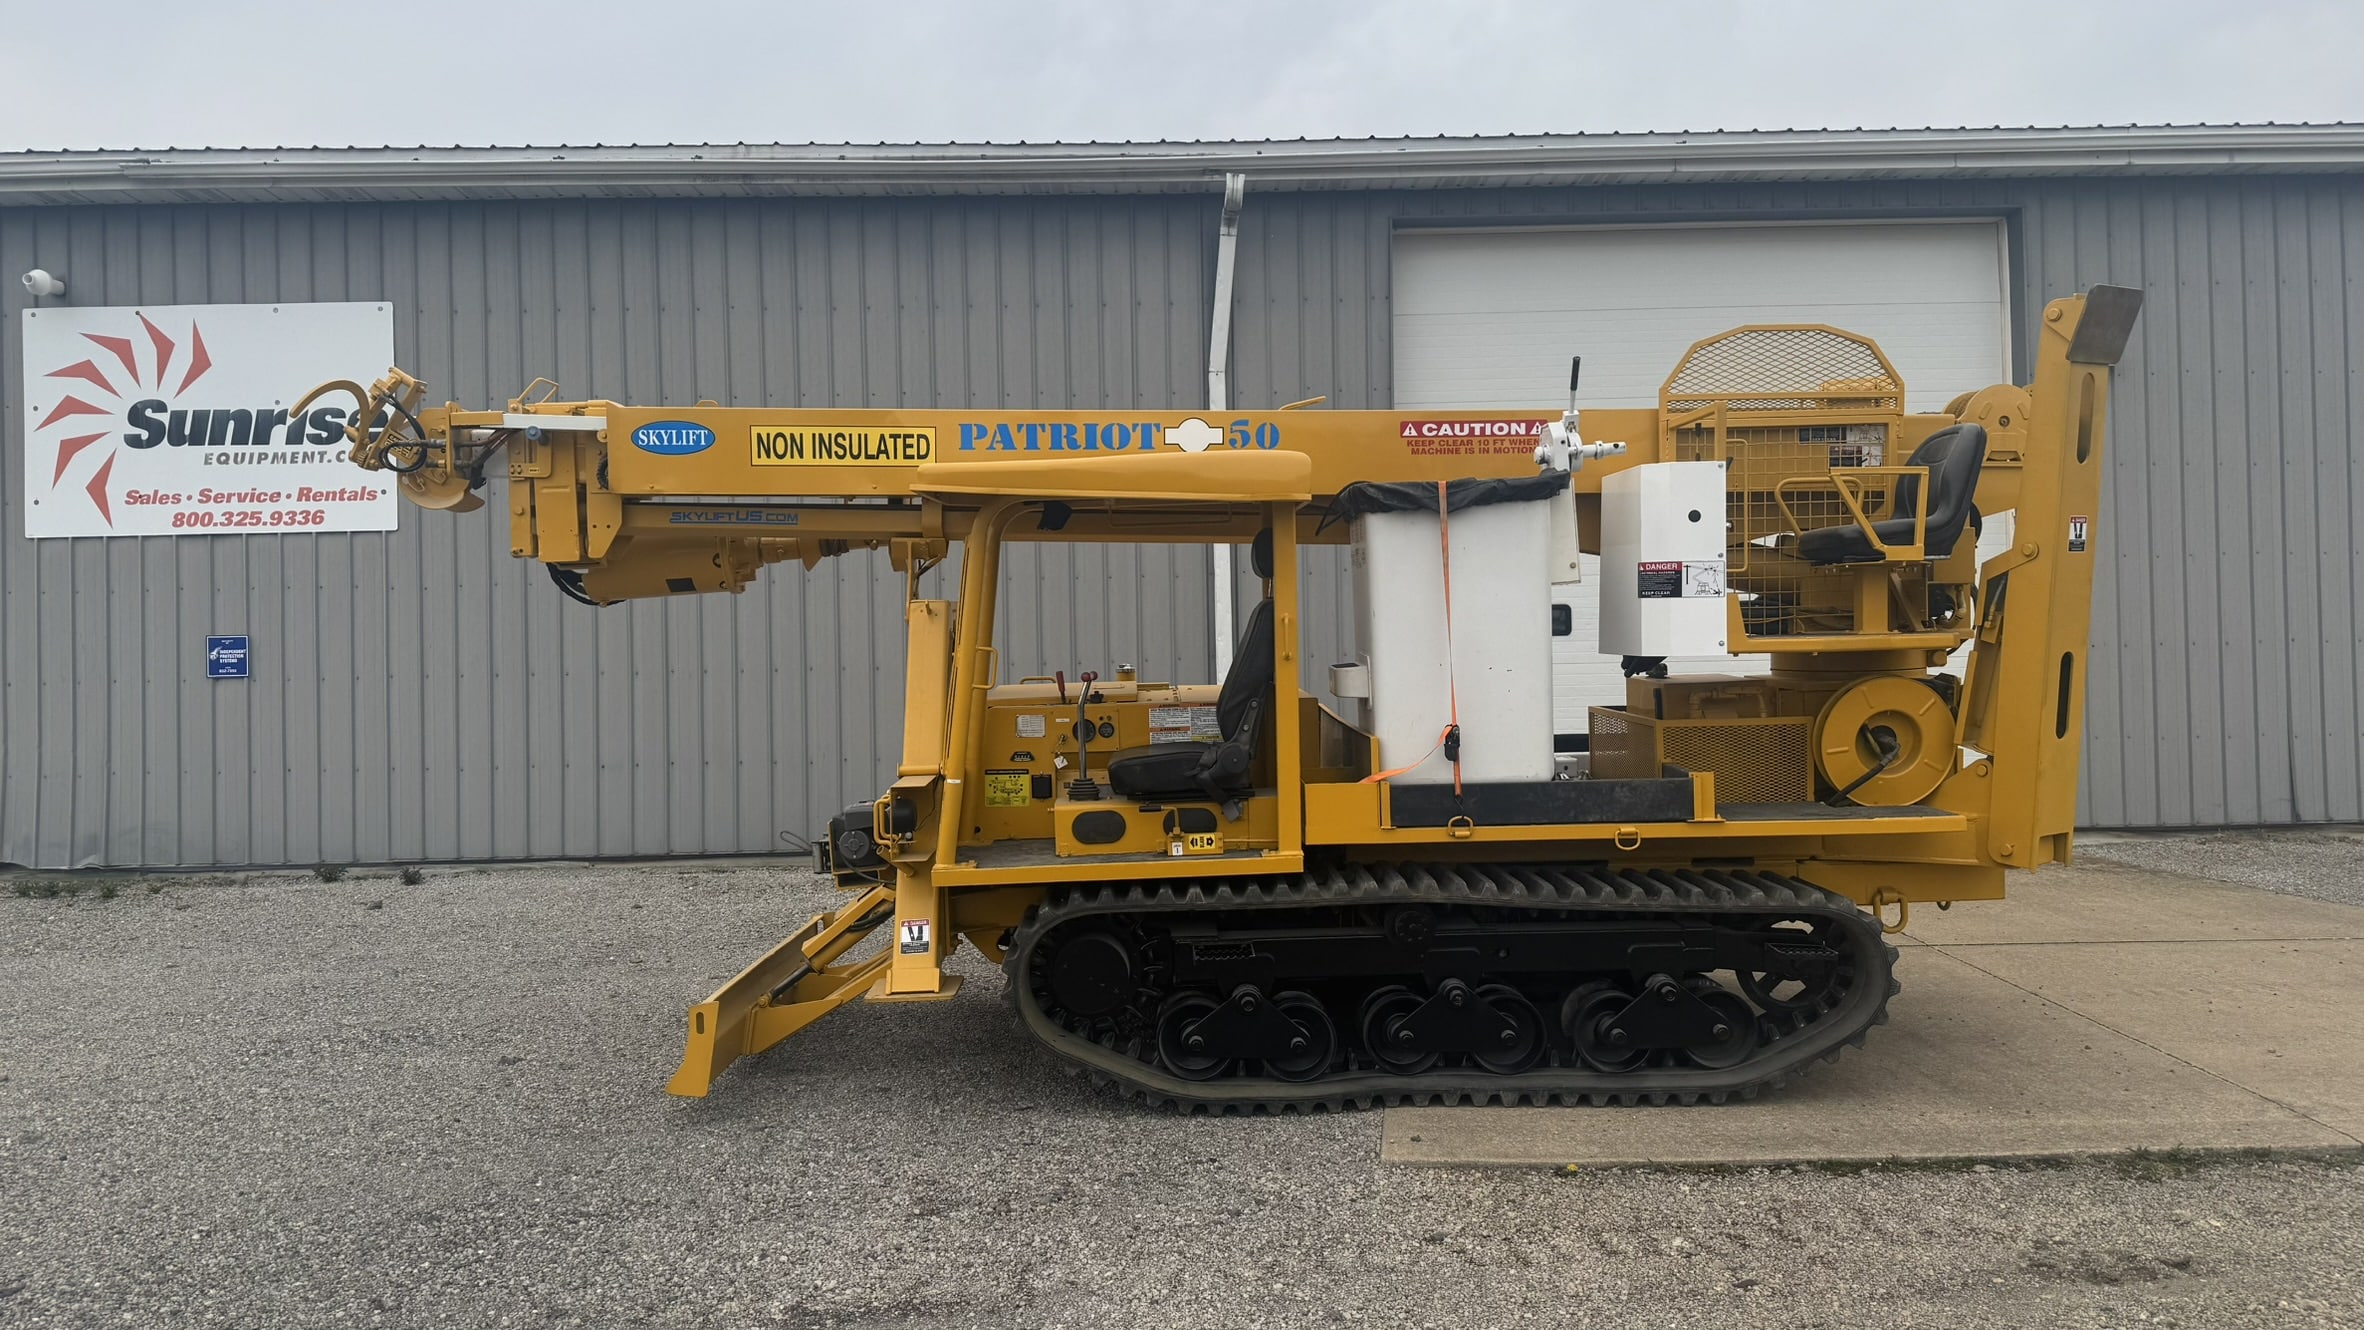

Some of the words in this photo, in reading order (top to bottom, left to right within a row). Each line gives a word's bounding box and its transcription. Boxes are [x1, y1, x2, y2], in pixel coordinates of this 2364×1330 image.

[638, 429, 708, 446] SKYLIFT
[958, 422, 1160, 450] PATRIOT
[1228, 419, 1280, 450] 50
[1421, 422, 1526, 437] CAUTION
[756, 431, 804, 460] NON
[812, 432, 931, 460] INSULATED
[1407, 439, 1435, 447] KEEP
[1438, 439, 1474, 447] CLEAR
[1478, 439, 1490, 447] 10
[1493, 439, 1505, 447] FT
[1508, 438, 1540, 446] WHEN
[1411, 447, 1461, 455] MACHINE
[1493, 446, 1536, 454] MOTION
[203, 450, 350, 466] EQUIPMENT.C
[124, 489, 182, 506] Sales
[197, 487, 281, 505] Service
[296, 486, 378, 503] Rentals
[171, 509, 325, 528] 800.325.9336
[670, 510, 798, 523] SKYLIFTUS.COM
[1645, 562, 1678, 570] DANGER
